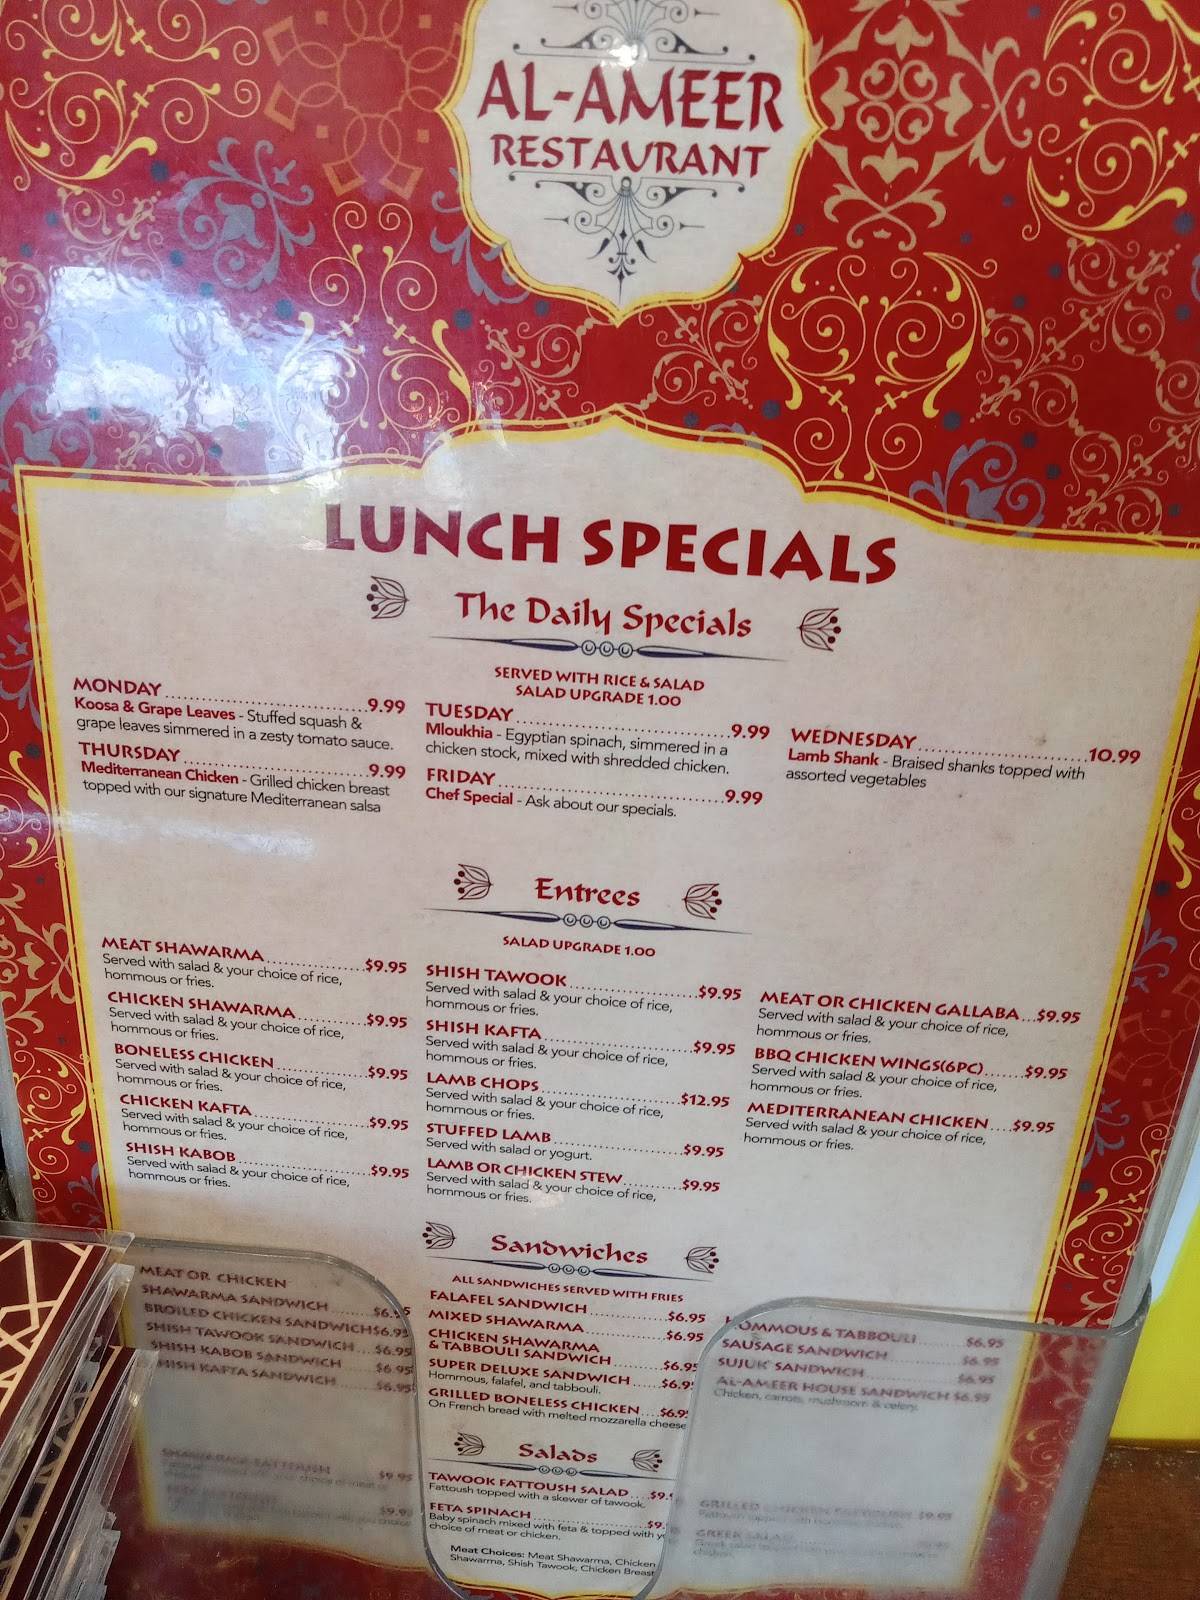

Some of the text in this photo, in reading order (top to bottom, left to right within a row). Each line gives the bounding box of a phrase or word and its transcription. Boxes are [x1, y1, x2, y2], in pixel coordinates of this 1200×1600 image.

[478, 60, 784, 132] AL-AMEER
[491, 133, 769, 177] RESTAURANT
[325, 504, 896, 604] LUNCH SPECIALS
[454, 591, 751, 638] The Daily Specials
[74, 678, 406, 713] MONDAY 9.99
[494, 666, 705, 692] SERVED WITH RICE & SALAD
[516, 684, 681, 707] SALAD UPGRADE 1.00
[74, 696, 119, 712] Koosa
[122, 699, 134, 713] &
[138, 701, 182, 719] Grape
[186, 704, 236, 720] Leaves
[247, 709, 296, 725] Stuffed
[299, 715, 347, 730] squash
[350, 716, 362, 730] &
[426, 703, 770, 740] TUESDAY 9.99
[76, 716, 393, 750] grape leaves simmered in a zesty tomato sauce.
[791, 728, 1141, 763] WEDNESDAY 10.99
[79, 741, 406, 778] THURSDAY 9.99
[425, 740, 729, 775] chicken stock, mixed with shredded chicken.
[82, 779, 381, 813] topped with our signature Mediterranean salsa
[427, 767, 763, 805] FRIDAY 9.99
[536, 877, 640, 907] Entrees
[102, 937, 407, 974] MEAT SHAWARMA $9.95
[503, 935, 656, 957] SALAD UPGRADE 1.00
[102, 952, 342, 986] Served with salad & your choice of rice,
[104, 967, 214, 988] hommous or fries.
[426, 965, 741, 1000] SHISH TAWOOK $9.95
[107, 991, 407, 1028] CHICKEN SHAWARMA $9.95
[761, 992, 1080, 1023] MEAT OR CHICKEN GALLABA $9.95
[426, 1019, 735, 1055] SHISH KAFTA $9.95
[114, 1043, 408, 1080] BONELESS CHICKEN $9.95
[755, 1048, 1068, 1079] BBQ CHICKEN WINGS(6PC) $9.95
[427, 1072, 730, 1106] LAMB CHOPS $12.95
[120, 1095, 408, 1130] CHICKEN KAFTA $9.95
[747, 1102, 1054, 1133] MEDITERRANEAN CHICKEN $9.95
[426, 1123, 724, 1157] STUFFED LAMB $9.95
[426, 1136, 592, 1161] Served with salad or yogurt.
[127, 1143, 409, 1179] SHISH KABOB $9.95
[427, 1157, 720, 1192] LAMB OR CHICKEN STEW $9.95
[491, 1235, 648, 1264] Sandwiches
[140, 1266, 287, 1289] MEAT OR CHICKEN
[452, 1275, 684, 1303] ALL SANDWICHES SERVED WITH FRIES
[430, 1290, 705, 1323] FALAFEL SANDWICH $6.95
[428, 1310, 704, 1342] MIXED SHAWARMA $6.95
[428, 1329, 600, 1353] CHICKEN SHAWARMA
[428, 1340, 612, 1365] & TABBOULI SANDWICH
[722, 1338, 999, 1368] SAUSAGE SANDWICH $6.95
[428, 1370, 601, 1394] Hommous, falafel, and tabbouli.
[518, 1443, 597, 1463] Salads
[450, 1544, 656, 1569] Meat Choices: Meat Shawarma, Chicken
